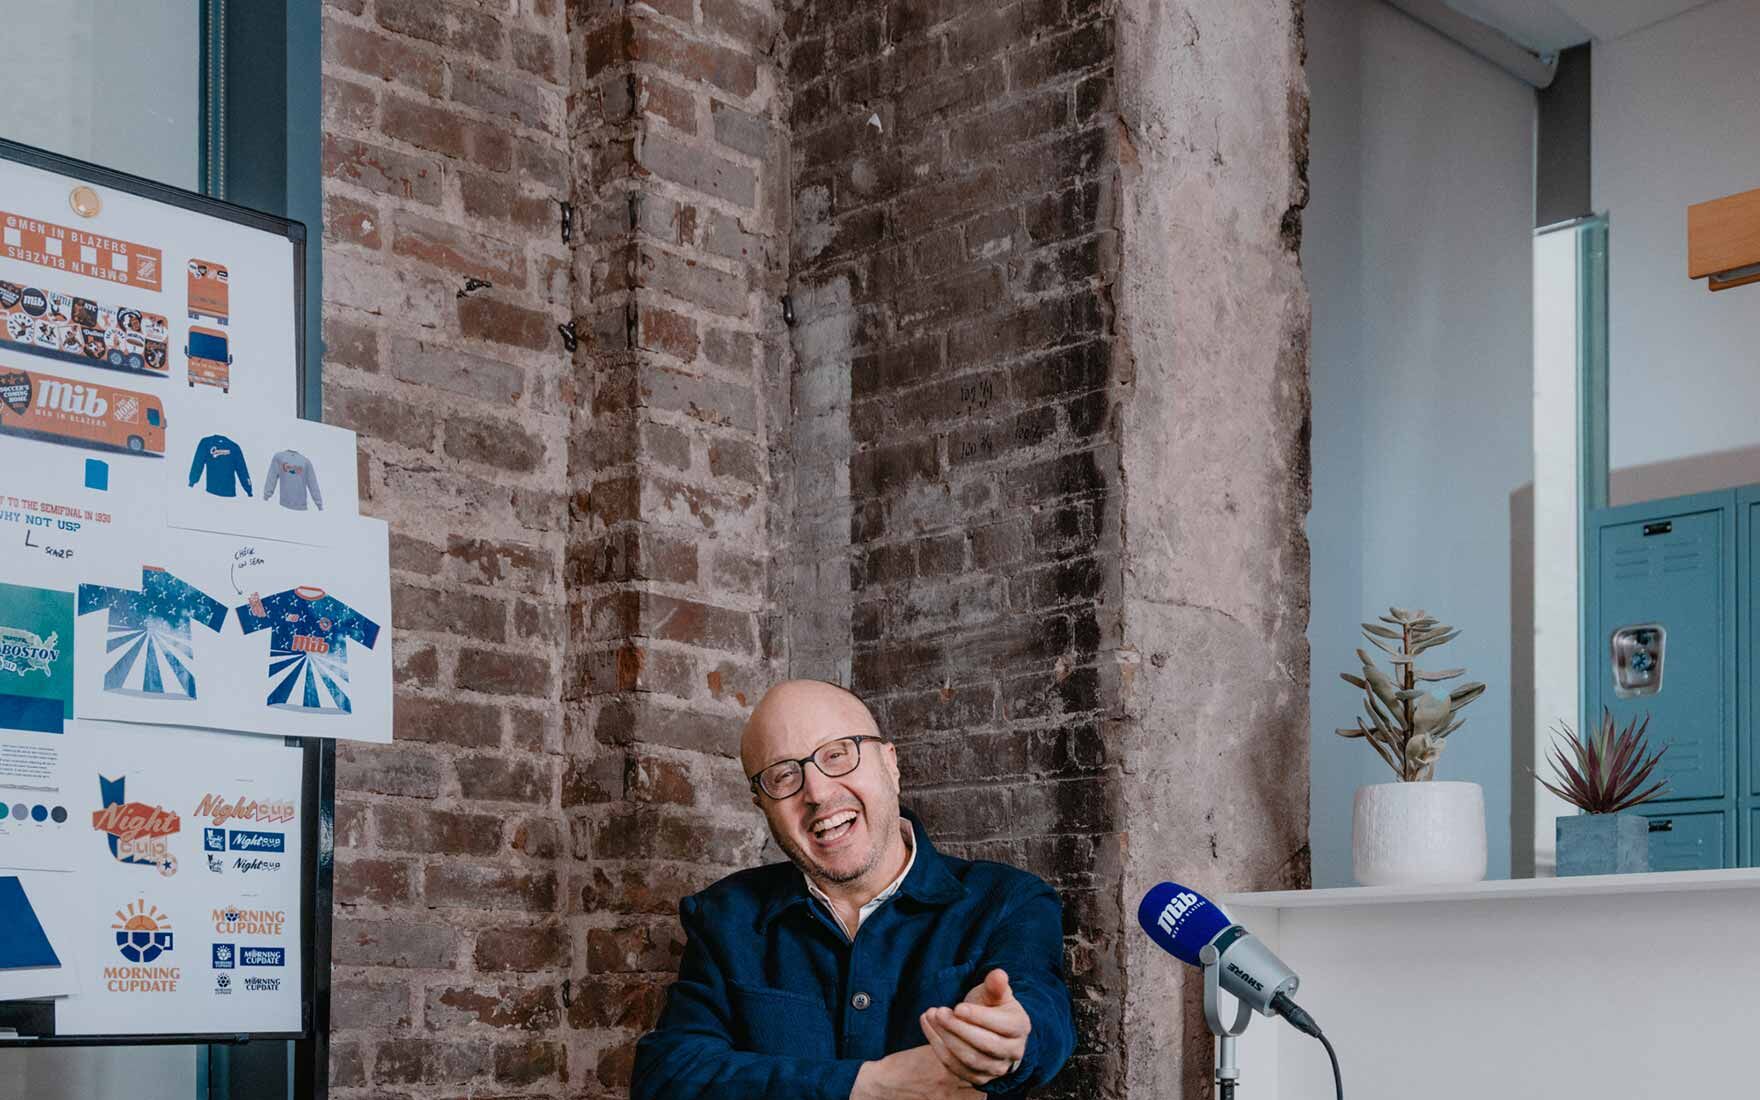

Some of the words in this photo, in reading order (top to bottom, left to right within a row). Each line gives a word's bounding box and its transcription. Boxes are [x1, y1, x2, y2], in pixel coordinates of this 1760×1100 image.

[6, 215, 45, 234] @MEN
[51, 226, 65, 239] IN
[71, 231, 127, 254] BLAZERS
[7, 246, 66, 270] BLAZERS
[21, 499, 38, 511] THE
[40, 502, 82, 519] SEMIFINAL
[84, 510, 93, 520] IN
[25, 514, 52, 527] NOT
[57, 519, 81, 532] US?
[2, 644, 59, 661] BOSTON
[95, 802, 176, 842] Night
[215, 921, 282, 935] CUPDATE
[246, 956, 280, 965] CUPDATE
[103, 966, 181, 980] MORNING
[1226, 962, 1265, 993] SHURE
[107, 979, 177, 992] CUPDATE
[246, 984, 280, 992] CUPDATE
